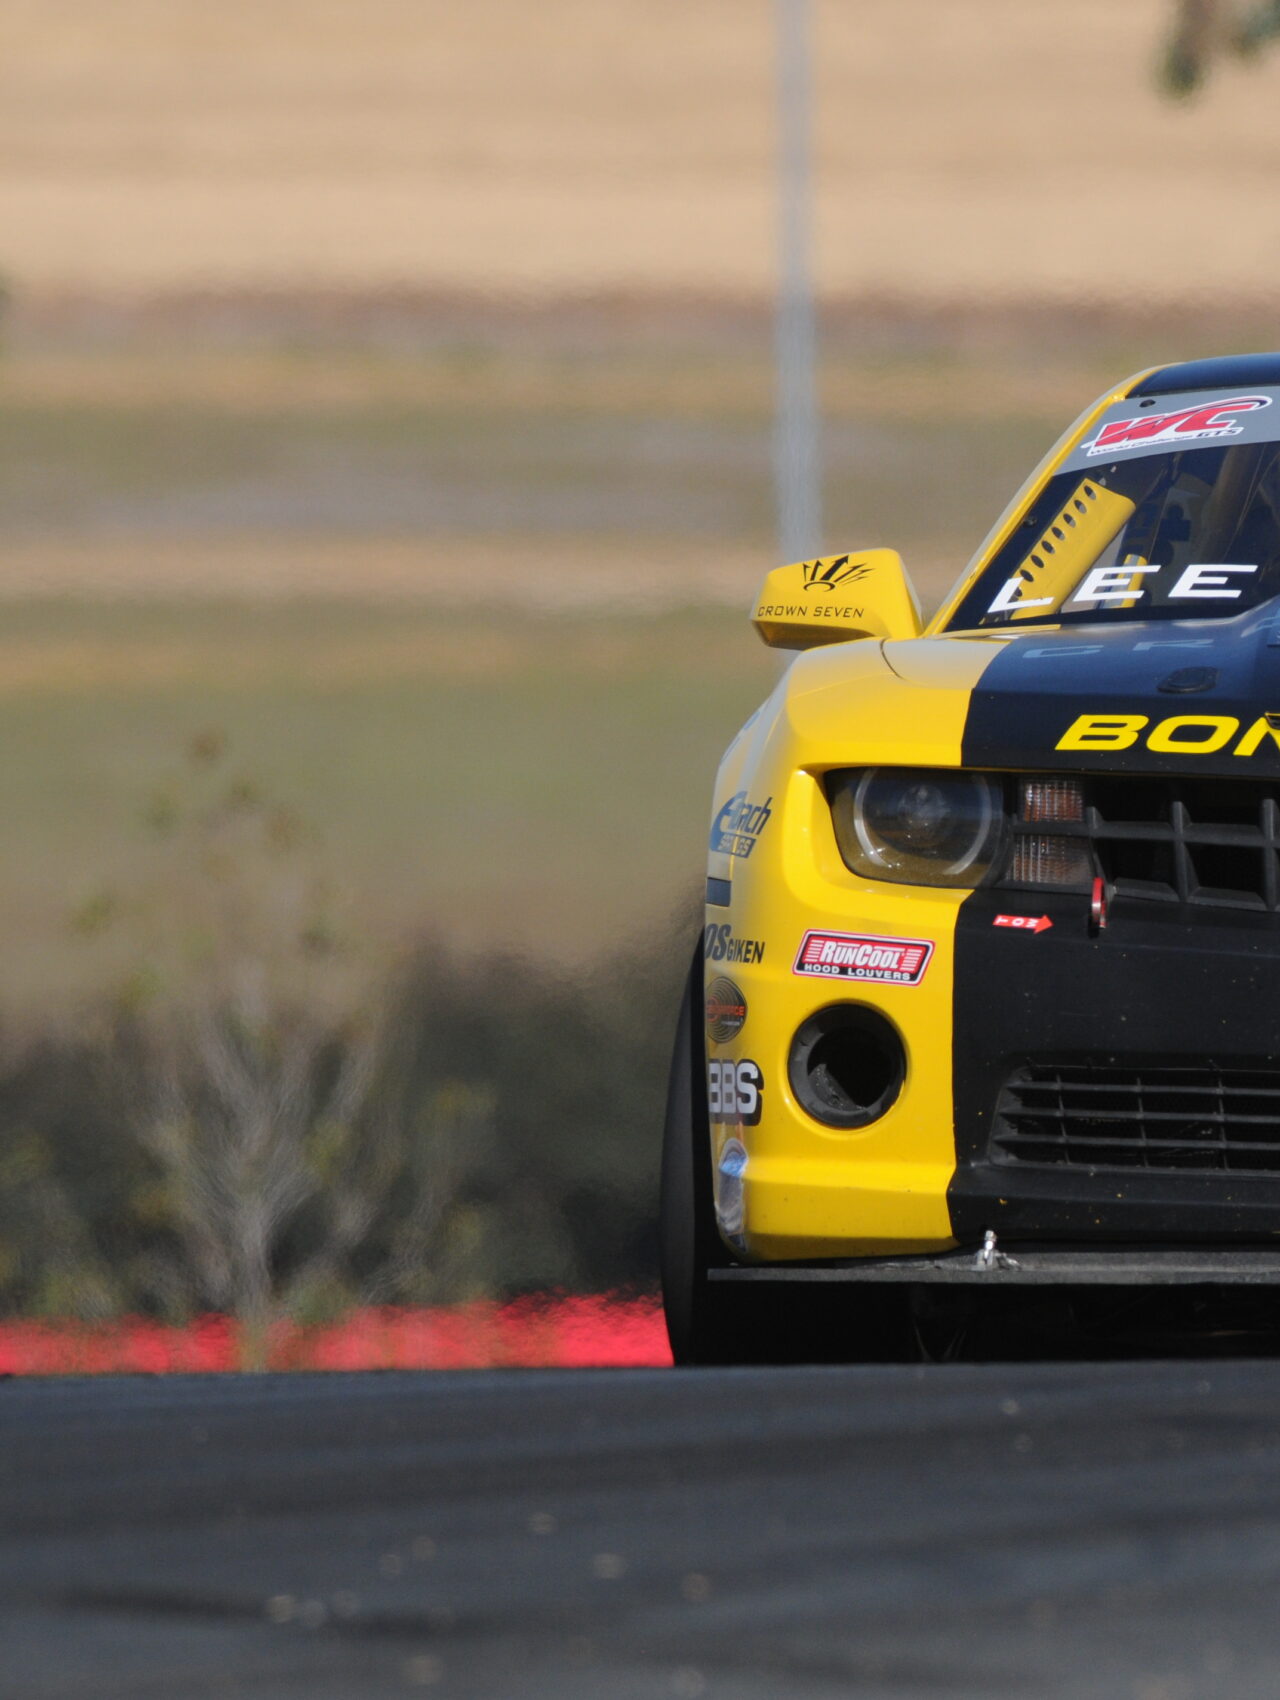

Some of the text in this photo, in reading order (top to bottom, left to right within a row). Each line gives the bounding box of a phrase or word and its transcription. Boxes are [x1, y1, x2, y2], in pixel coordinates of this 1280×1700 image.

[987, 563, 1259, 614] LEE
[757, 605, 865, 618] CROWN SEVEN
[995, 916, 1040, 929] TOW
[726, 939, 766, 964] GIKEN
[803, 963, 911, 981] HOOD LOUVERS
[709, 1059, 764, 1125] BBS
